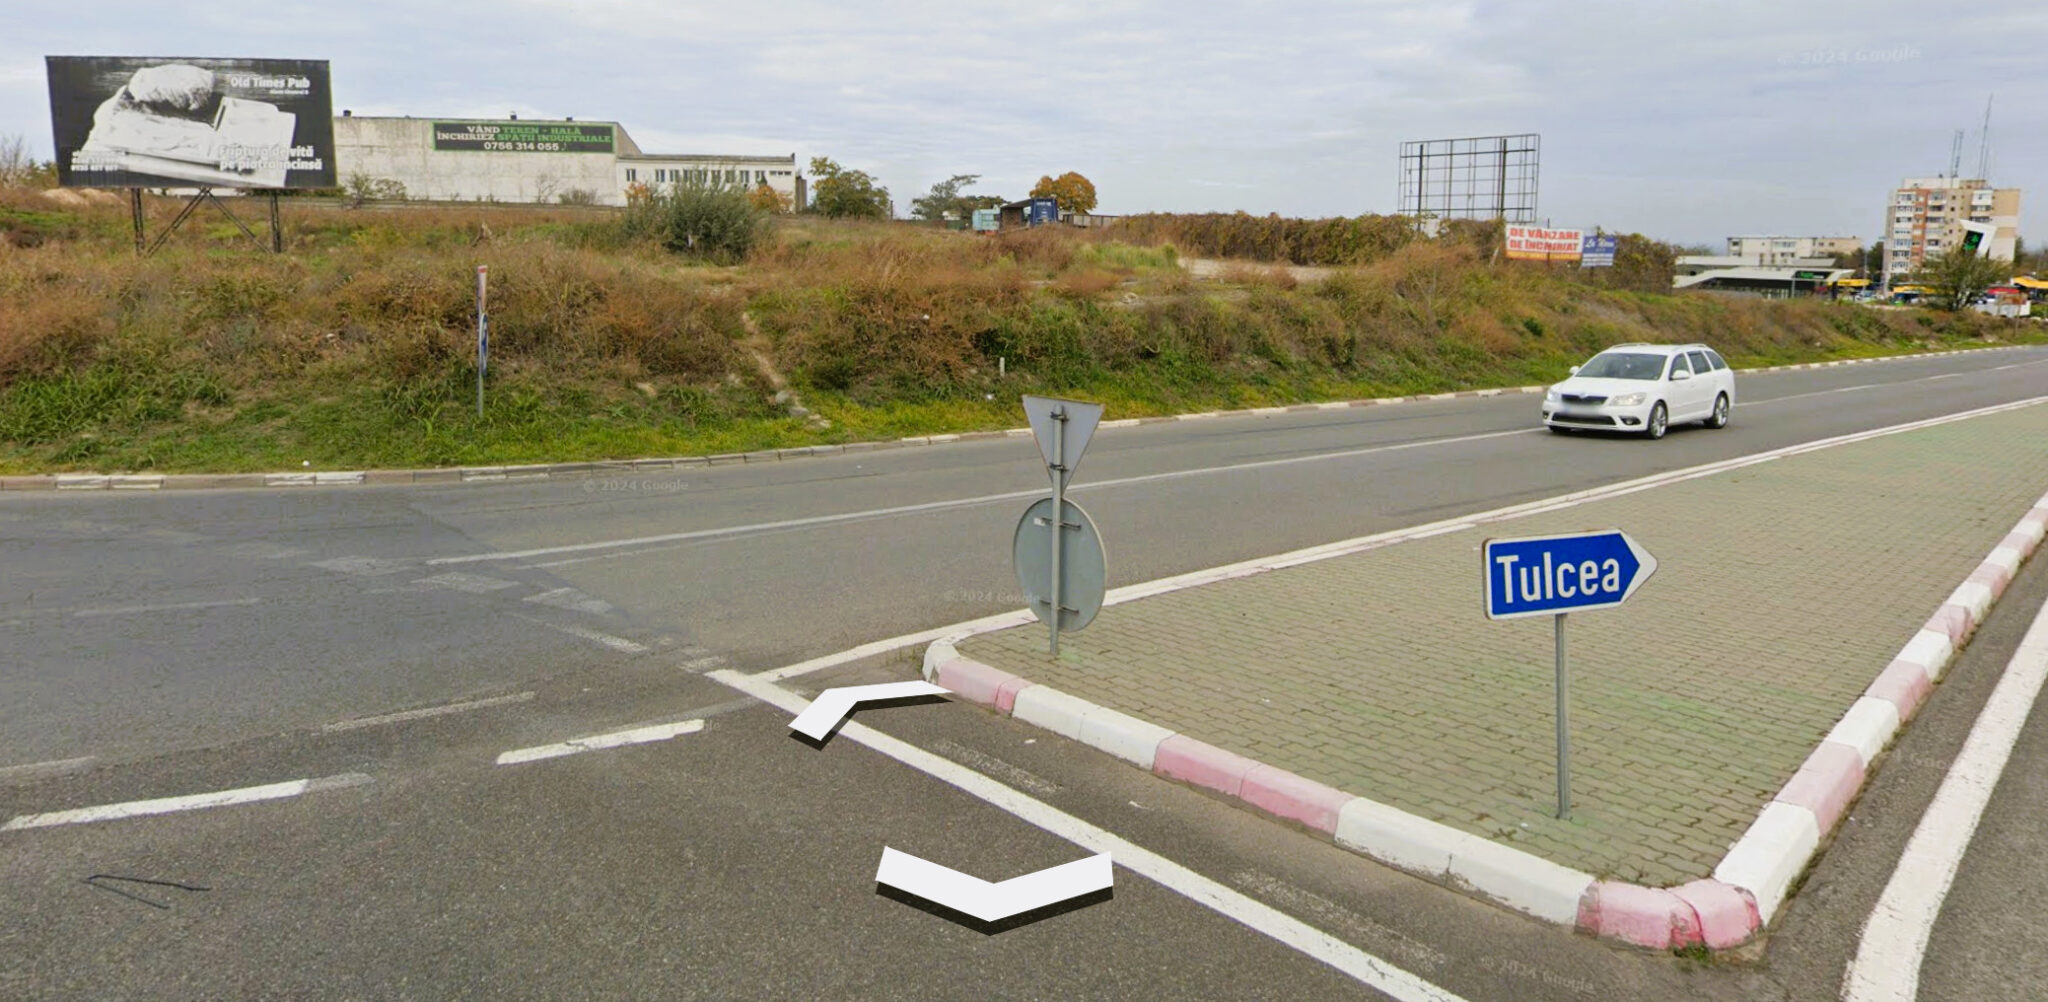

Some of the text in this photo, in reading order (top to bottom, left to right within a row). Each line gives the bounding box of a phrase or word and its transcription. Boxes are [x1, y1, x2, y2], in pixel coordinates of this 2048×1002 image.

[230, 76, 311, 89] Old Times Pub
[437, 131, 495, 142] ÎNCHIRIEZ
[484, 141, 513, 151] 0756
[515, 142, 535, 151] 314
[1510, 228, 1525, 237] DE
[1509, 239, 1523, 249] DE
[1496, 551, 1620, 604] Tulcea
